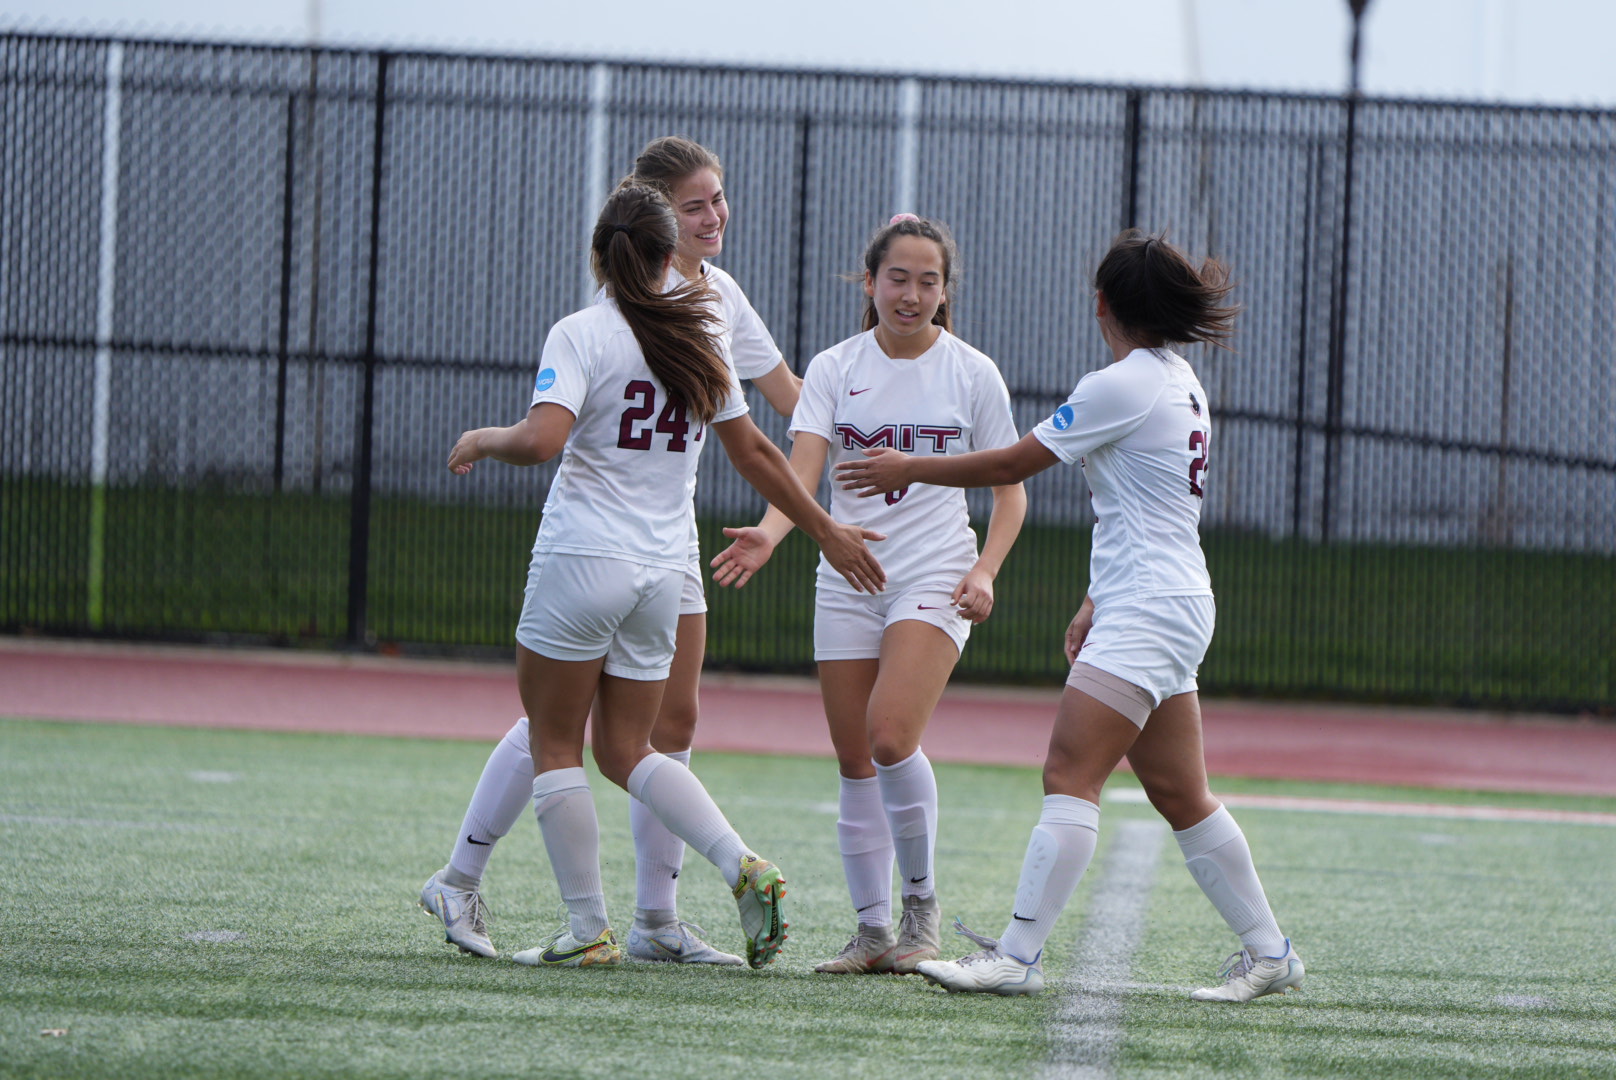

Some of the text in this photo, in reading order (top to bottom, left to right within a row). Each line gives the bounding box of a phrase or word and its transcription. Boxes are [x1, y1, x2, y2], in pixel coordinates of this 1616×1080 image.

[617, 380, 690, 452] 24
[834, 423, 961, 453] MIT
[1055, 411, 1069, 429] NCAA
[1189, 431, 1208, 499] 2
